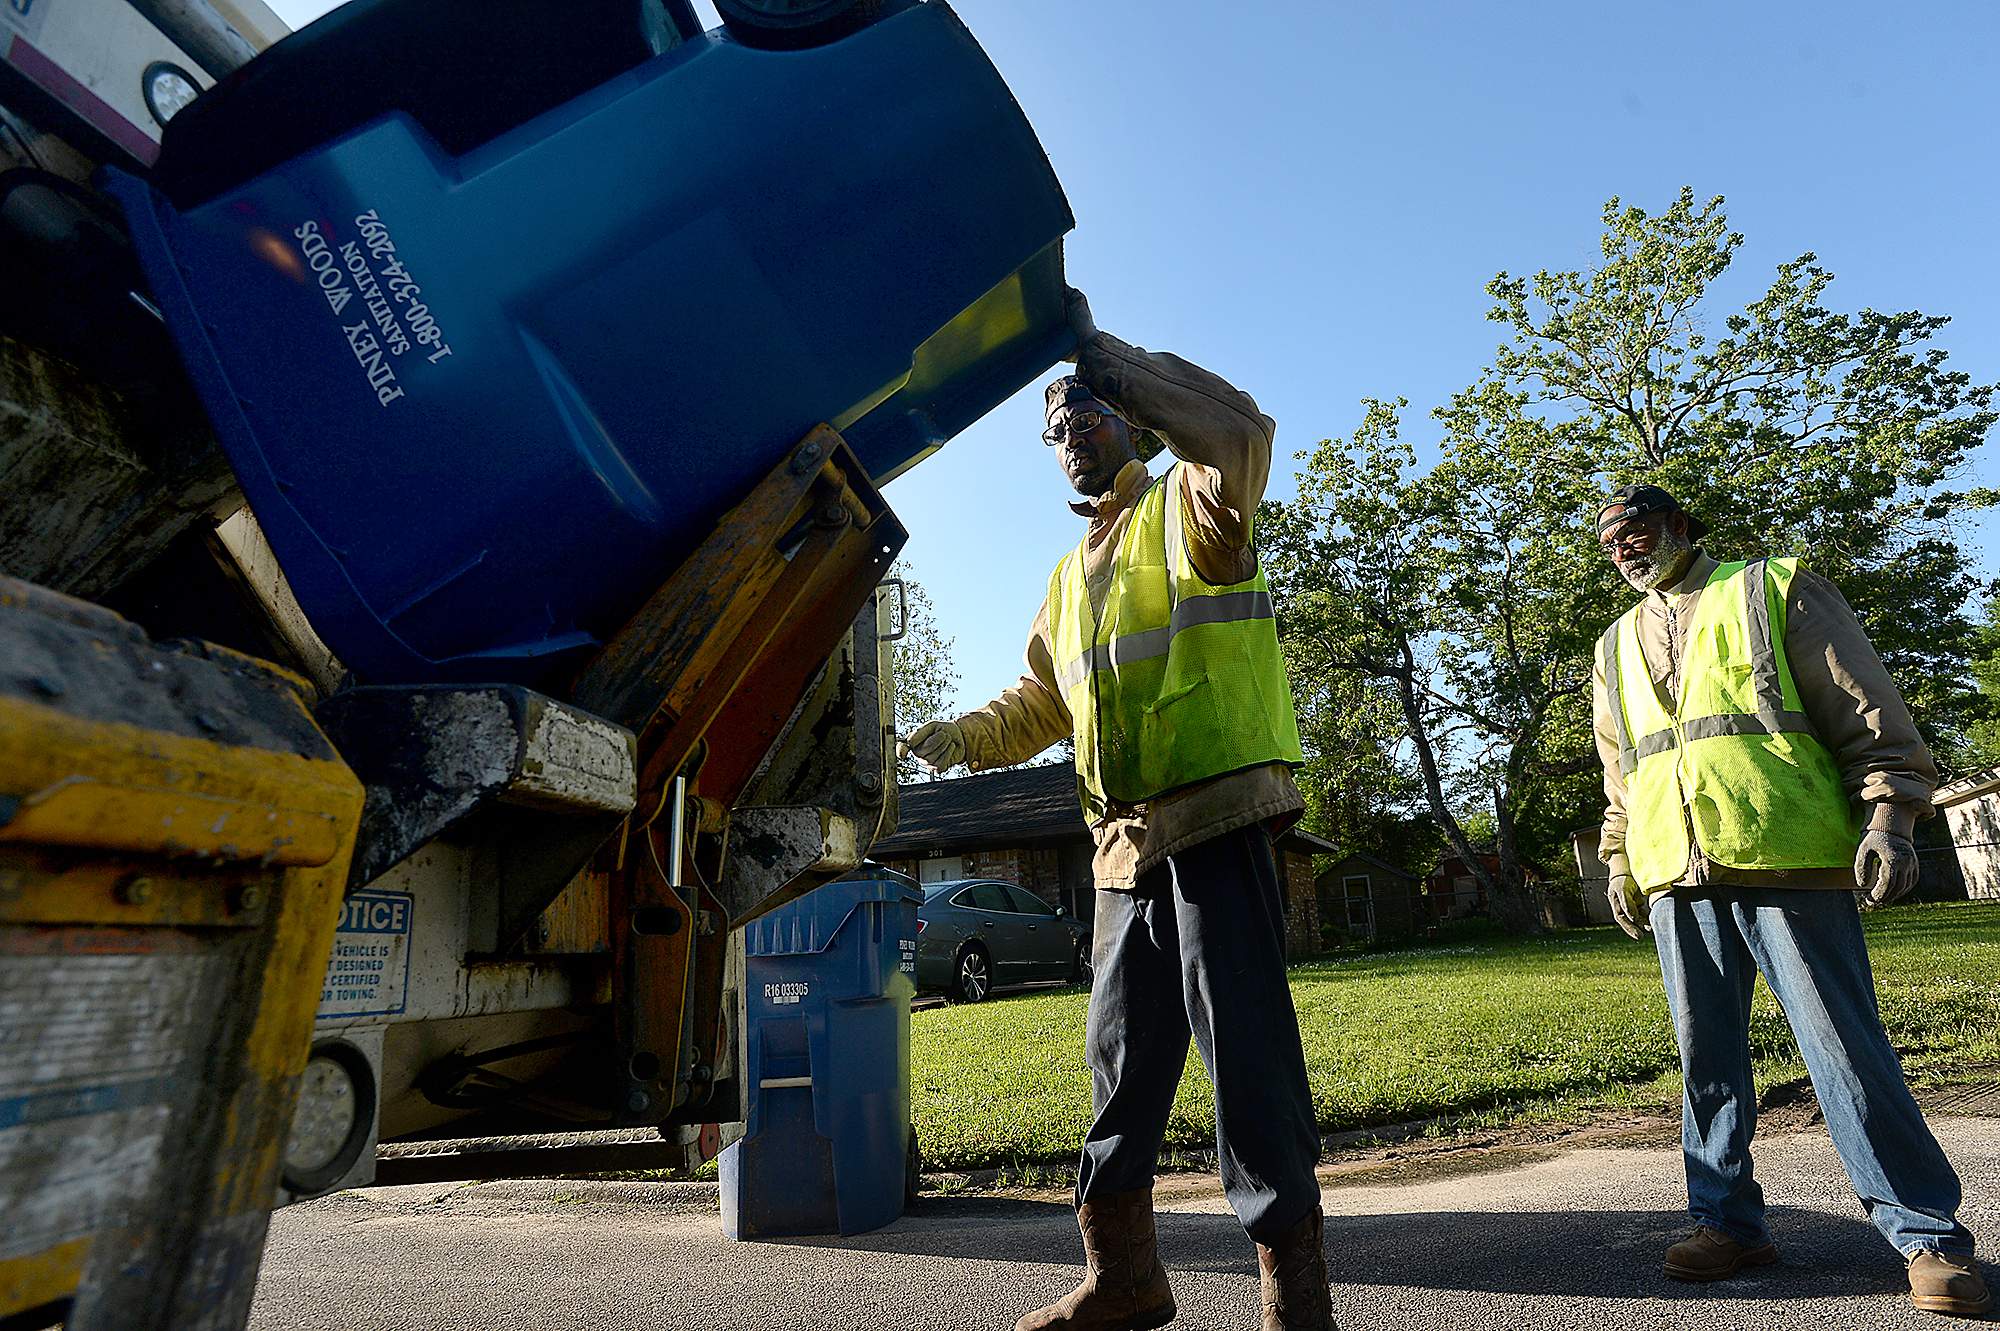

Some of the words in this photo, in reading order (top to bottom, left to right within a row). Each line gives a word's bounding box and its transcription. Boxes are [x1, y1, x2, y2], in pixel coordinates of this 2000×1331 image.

[294, 220, 353, 316] WOODS
[355, 209, 452, 364] 1-800-324-2092
[339, 241, 411, 356] SANITATION
[342, 320, 405, 407] PINEY
[928, 849, 943, 858] 301
[337, 945, 377, 957] VEHICLE
[380, 946, 389, 956] IS
[337, 960, 384, 971] DESIGNED
[331, 974, 380, 986] CERTIFIED
[337, 988, 377, 1001] TOWING.
[764, 983, 780, 997] R16
[781, 982, 809, 996] 033305
